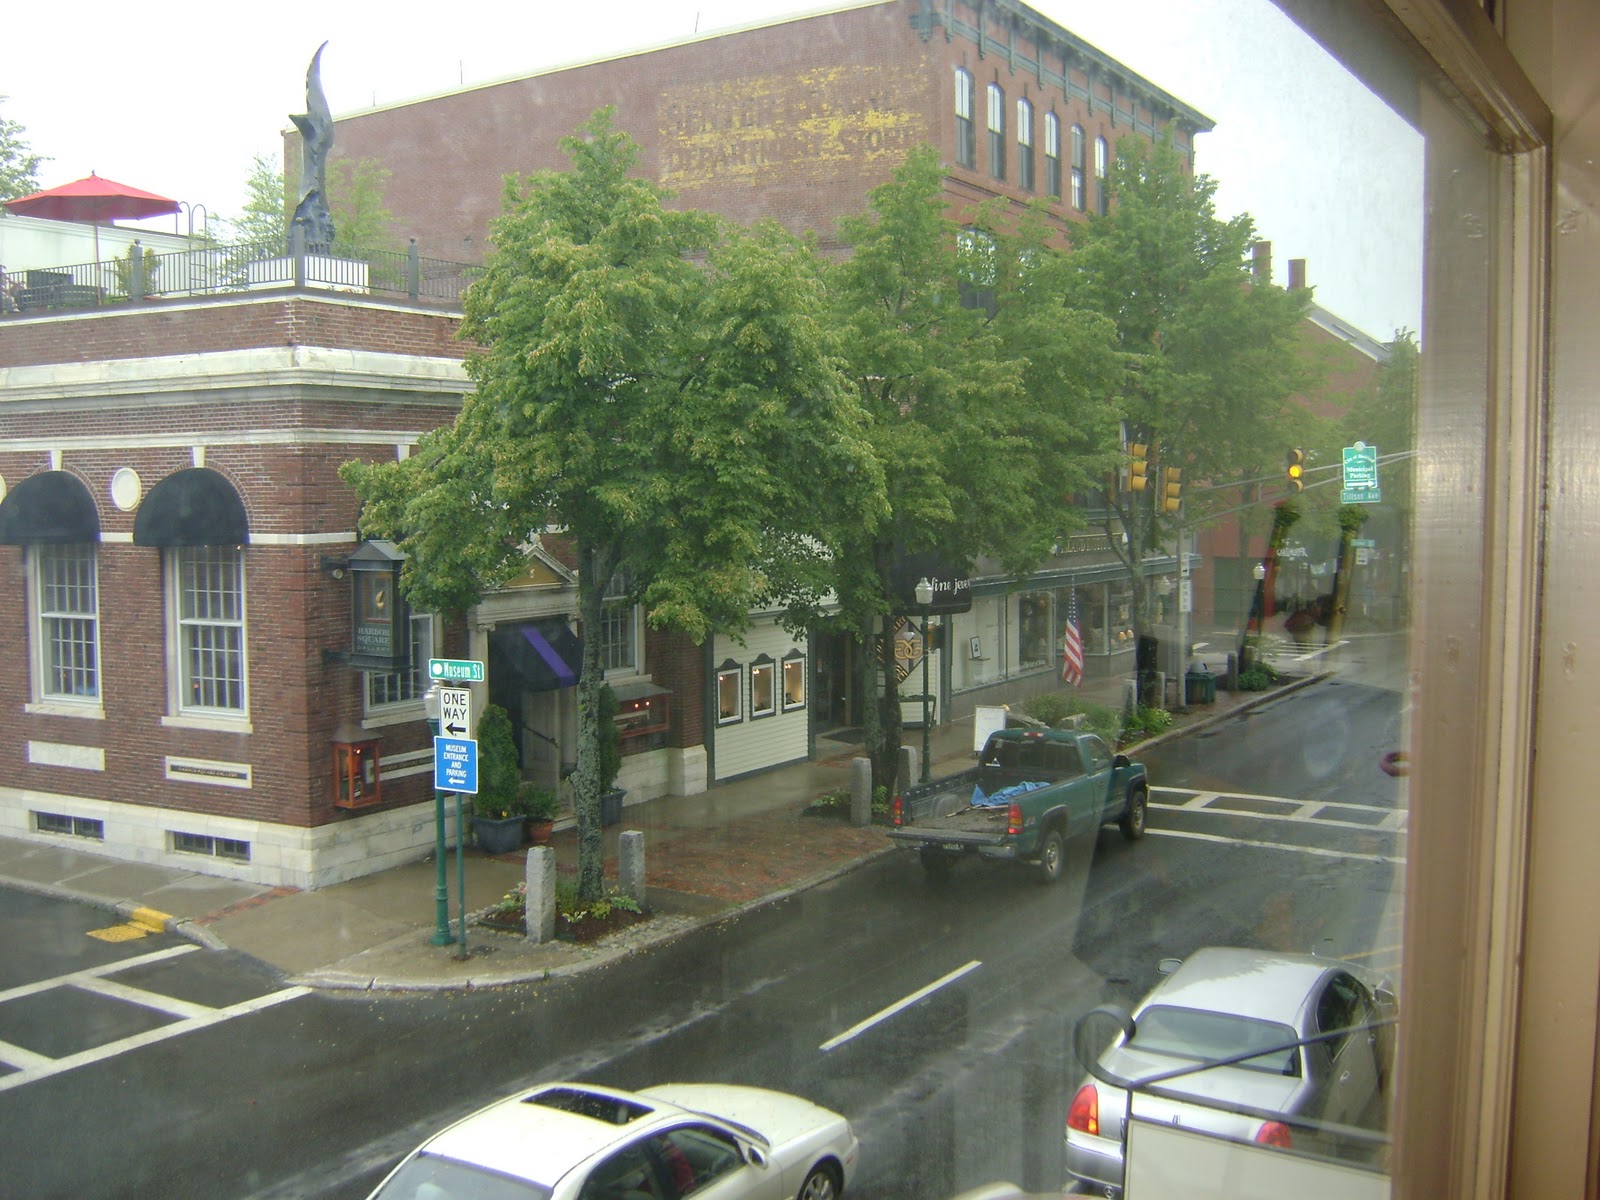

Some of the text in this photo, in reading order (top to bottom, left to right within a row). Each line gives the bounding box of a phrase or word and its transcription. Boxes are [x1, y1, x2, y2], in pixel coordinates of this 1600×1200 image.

[1342, 491, 1379, 501] Tillson Ave
[931, 577, 951, 592] fine
[358, 628, 390, 636] HARBOR
[357, 635, 390, 644] SQUARE
[443, 662, 481, 679] Museum St
[443, 692, 466, 706] ONE
[443, 706, 467, 721] WAY
[445, 744, 467, 753] MUSEUM
[443, 752, 469, 762] ENTRANCE
[451, 761, 462, 769] AND
[445, 768, 467, 778] PARKING
